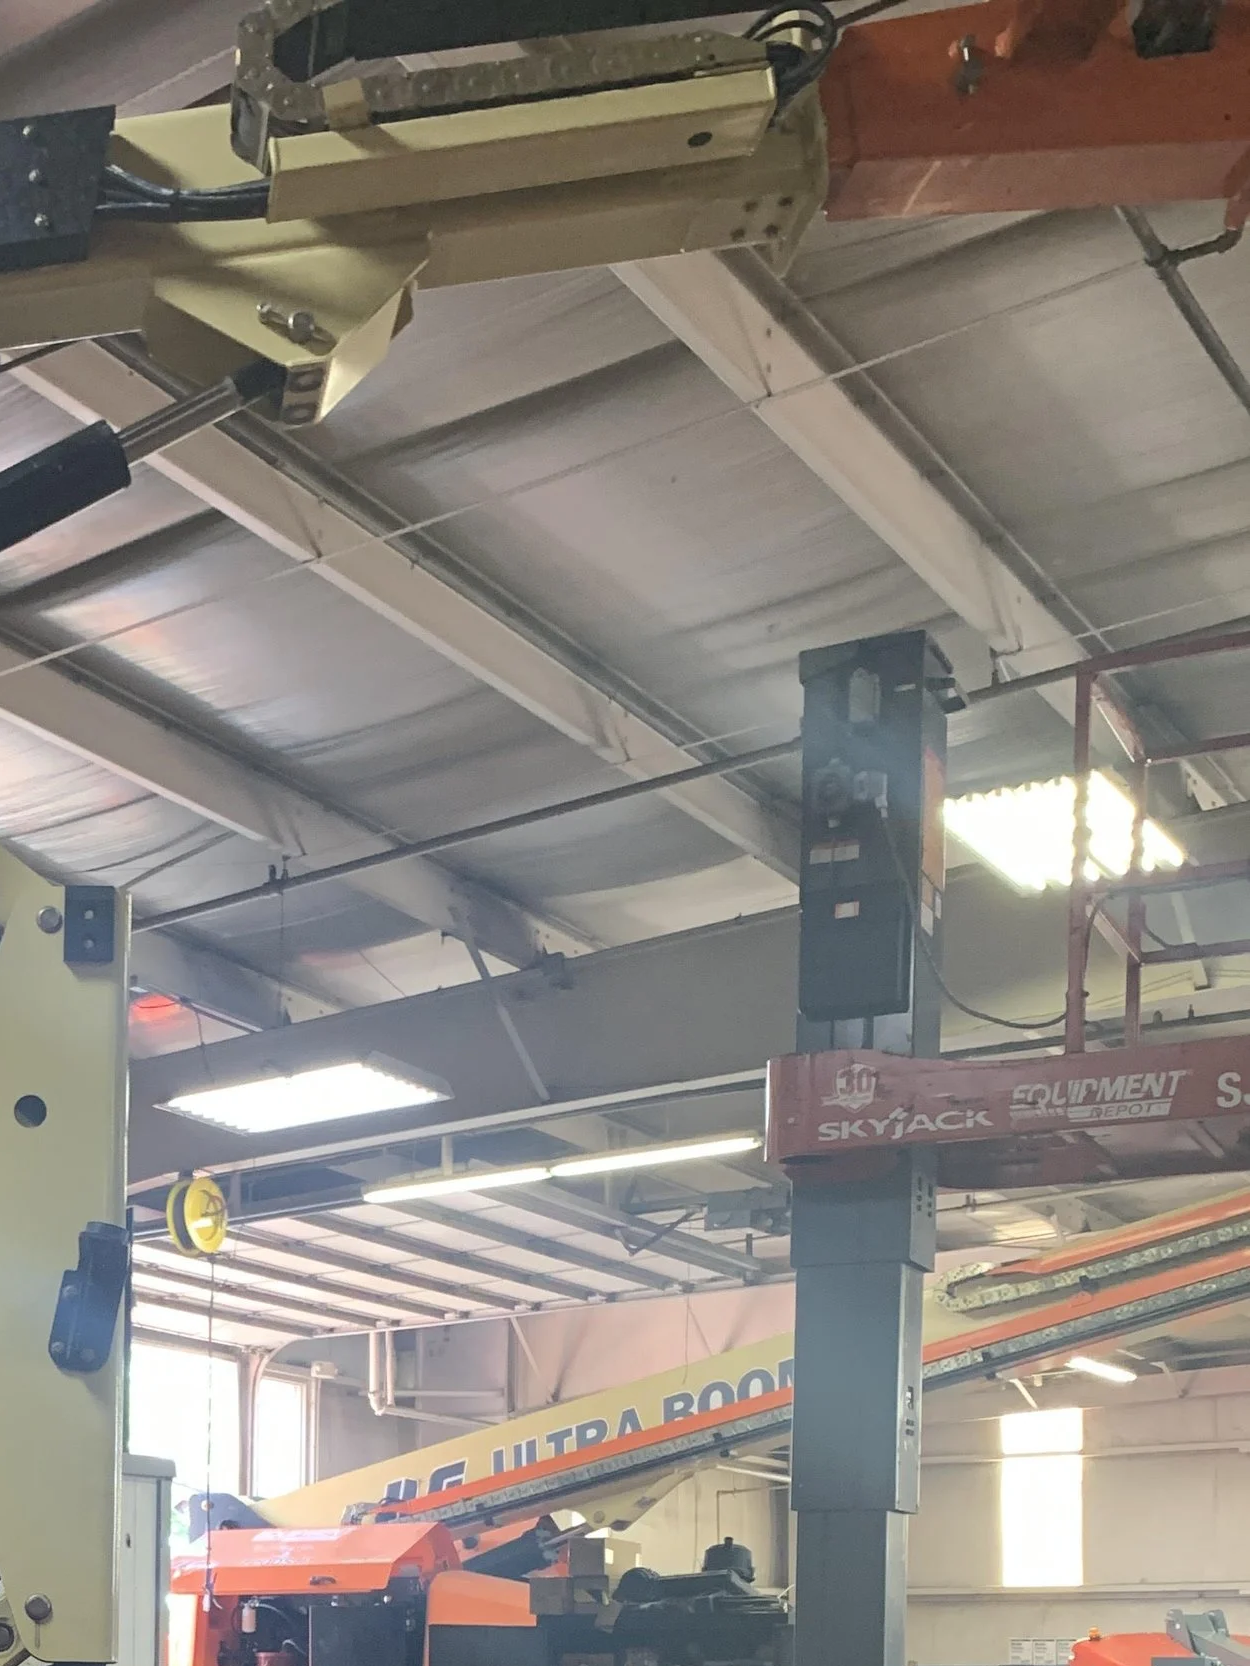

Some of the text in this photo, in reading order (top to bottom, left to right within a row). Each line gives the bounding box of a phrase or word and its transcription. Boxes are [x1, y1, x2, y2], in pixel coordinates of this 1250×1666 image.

[1012, 1070, 1188, 1107] EQUIPMENT
[1216, 1071, 1250, 1109] S
[817, 1107, 995, 1142] SKYJACK
[1089, 1101, 1154, 1119] DEPOT
